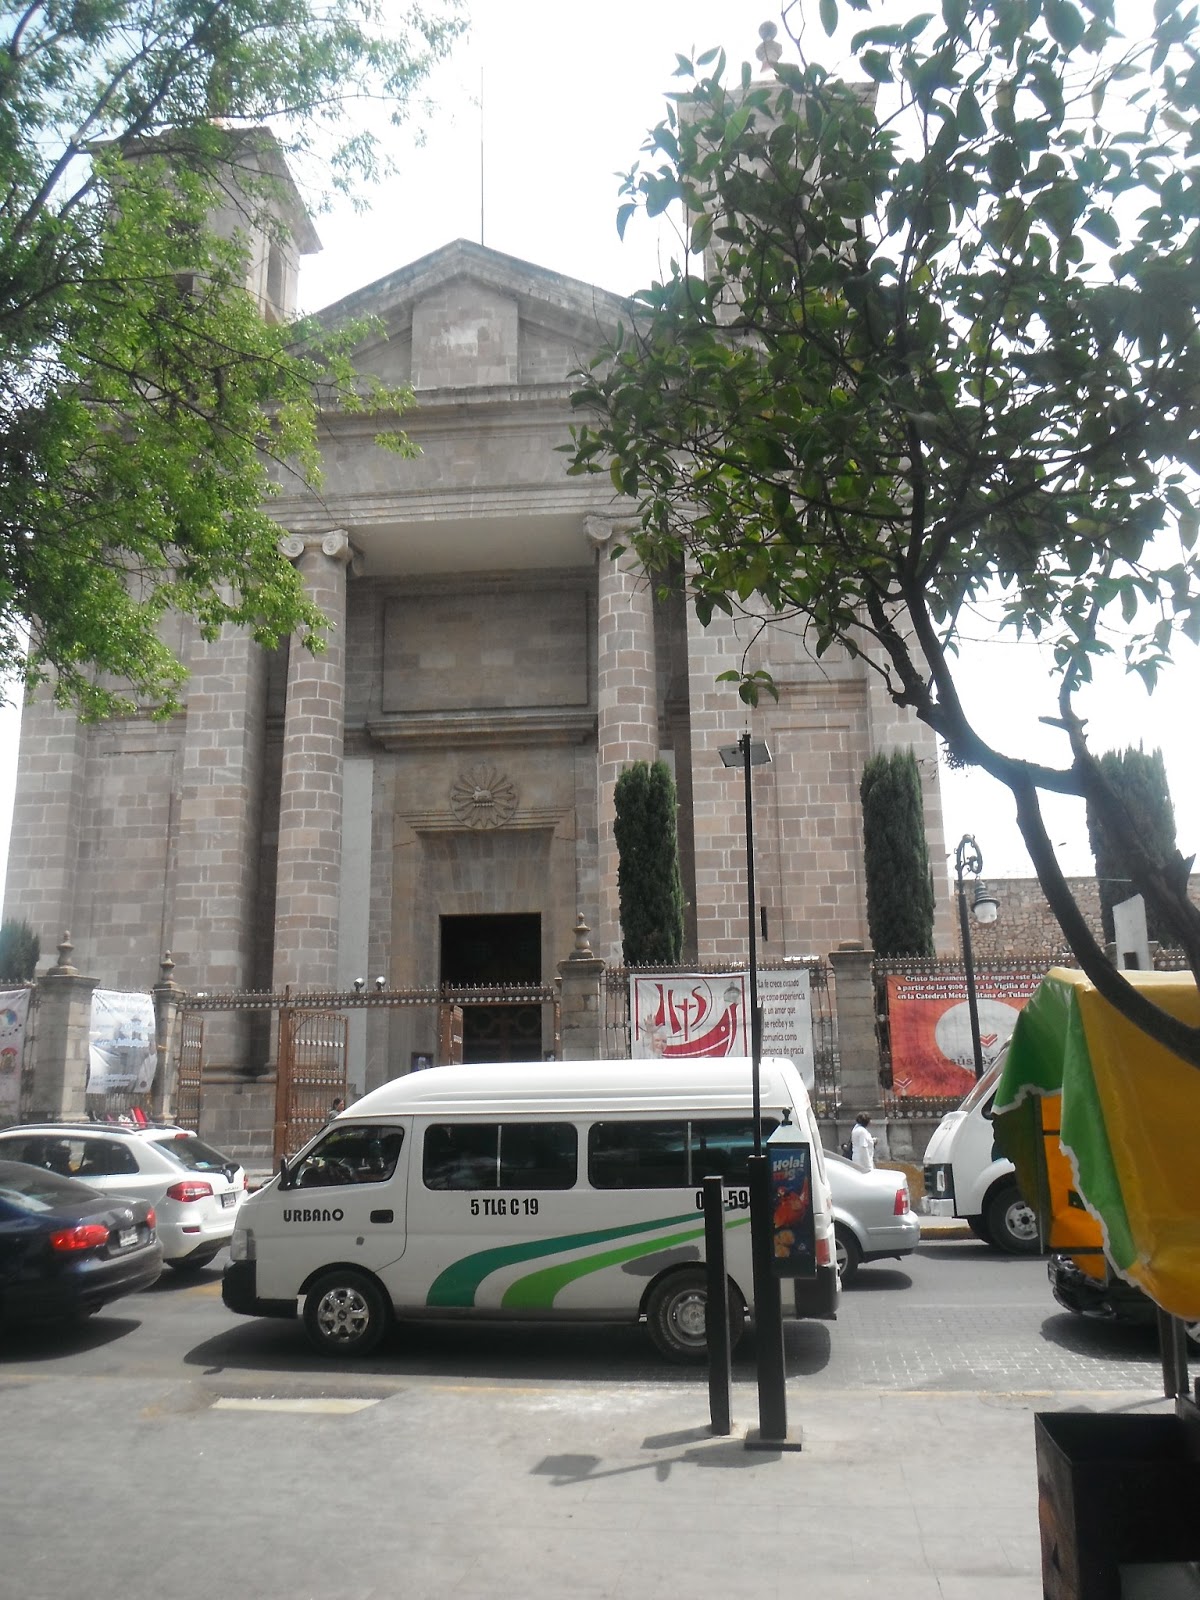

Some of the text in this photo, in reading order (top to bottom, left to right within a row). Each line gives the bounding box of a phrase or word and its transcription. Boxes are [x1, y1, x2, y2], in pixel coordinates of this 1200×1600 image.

[902, 984, 925, 992] partir
[994, 982, 1018, 990] Vigilia
[773, 1152, 804, 1172] Hola!
[471, 1198, 539, 1216] 5 TLG C 19
